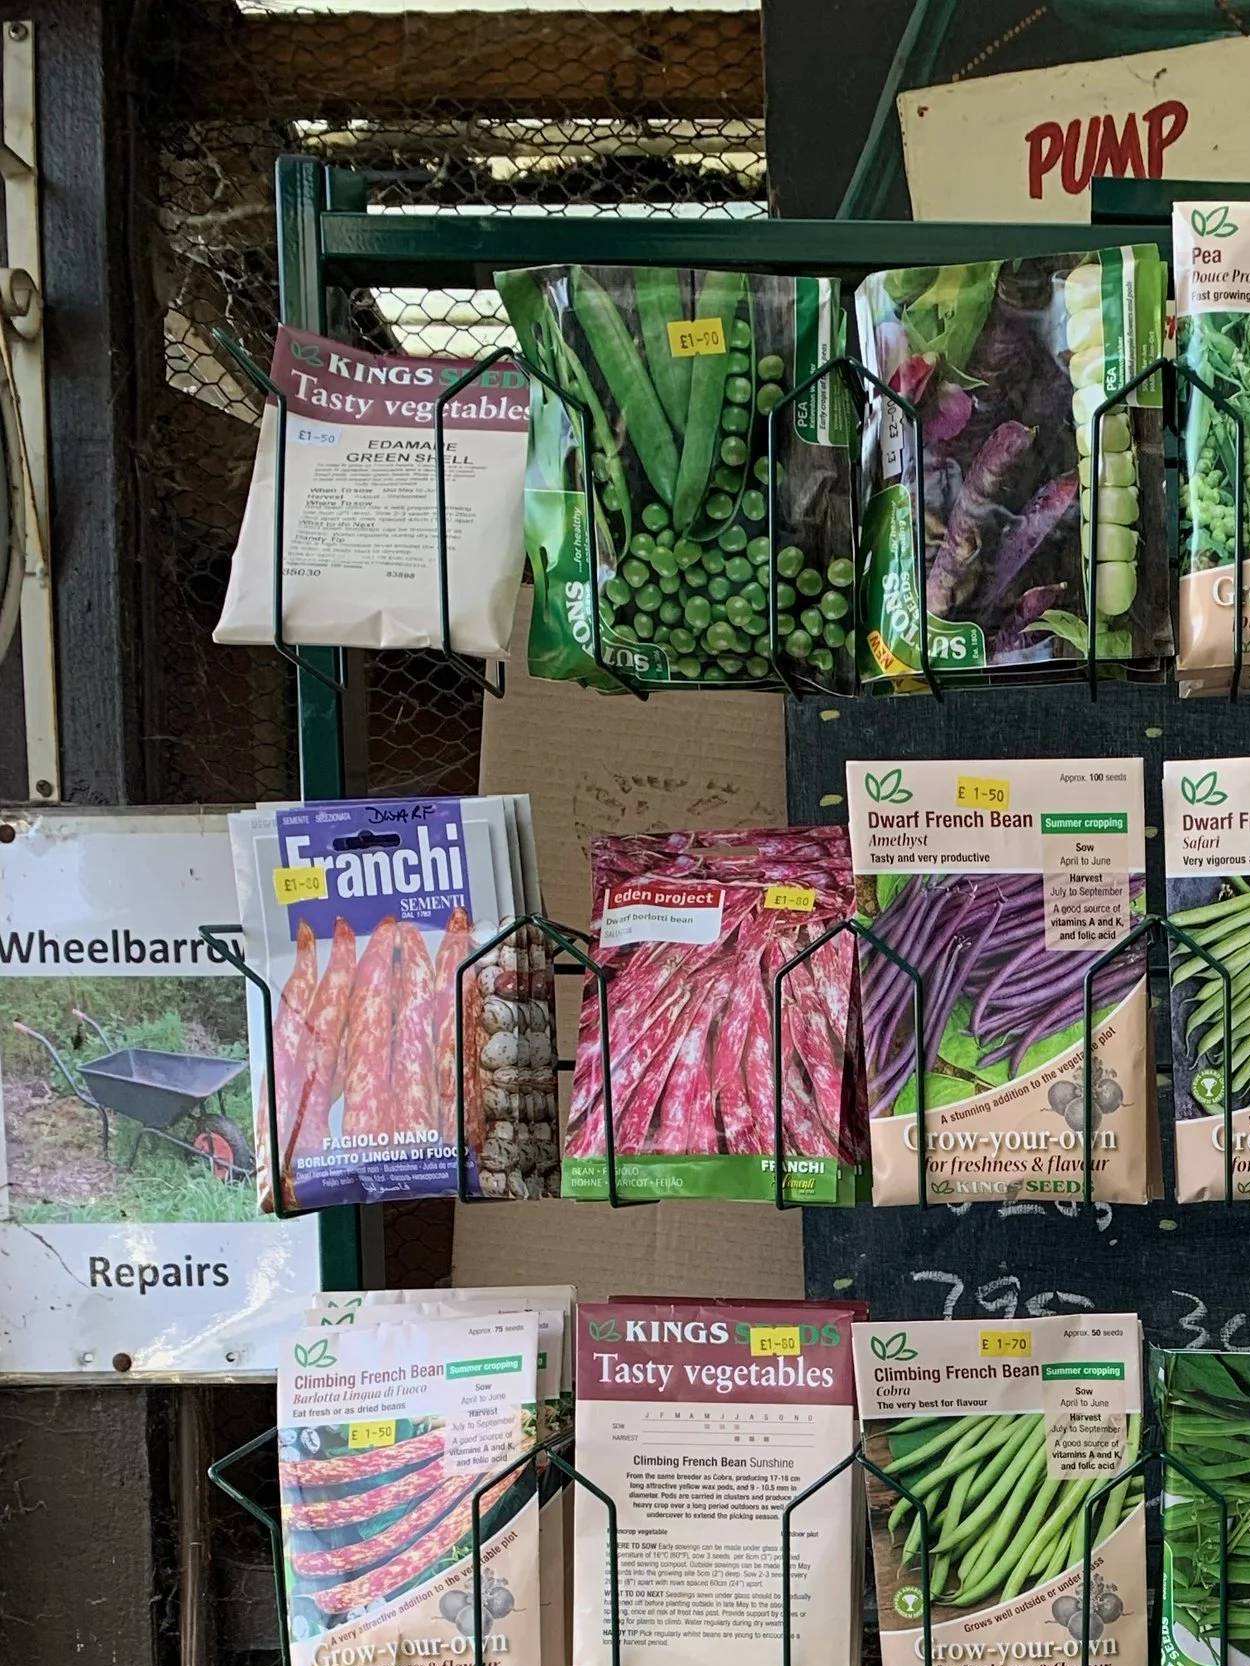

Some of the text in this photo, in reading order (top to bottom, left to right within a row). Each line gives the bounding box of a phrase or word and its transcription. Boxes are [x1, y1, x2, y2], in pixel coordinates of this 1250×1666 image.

[1025, 100, 1188, 199] PUMP
[1192, 248, 1222, 264] Pea
[1192, 270, 1229, 284] Douce
[679, 330, 719, 349] £1-90
[327, 353, 433, 385] KINGS
[290, 369, 375, 418] Tasty
[298, 430, 335, 443] £1-50
[347, 453, 410, 462] GREEN
[972, 786, 1004, 802] 1-50
[868, 811, 1033, 828] Dwarf French Bean
[1182, 812, 1233, 832] Dwarf
[869, 834, 928, 848] Amethyst
[1182, 836, 1220, 850] Safari
[870, 852, 990, 864] Tasty and very productive
[1183, 856, 1204, 866] Very
[1206, 854, 1246, 866] vigorous
[400, 895, 465, 912] SEMENTI
[614, 890, 714, 906] eden project
[633, 913, 694, 925] borlotti bean
[322, 1130, 439, 1150] FAGIOLO NANO
[297, 1148, 424, 1169] BORLOTTO LINGUA DI
[89, 1255, 229, 1295] Repairs
[626, 1321, 728, 1344] KINGS
[760, 1338, 795, 1350] £1-80
[996, 1338, 1027, 1350] 1-70
[593, 1352, 834, 1394] Tasty vegetables
[876, 1386, 911, 1397] Cobra
[366, 1426, 392, 1439] 1-50
[633, 1455, 794, 1468] Climbing French Bean Sunshine
